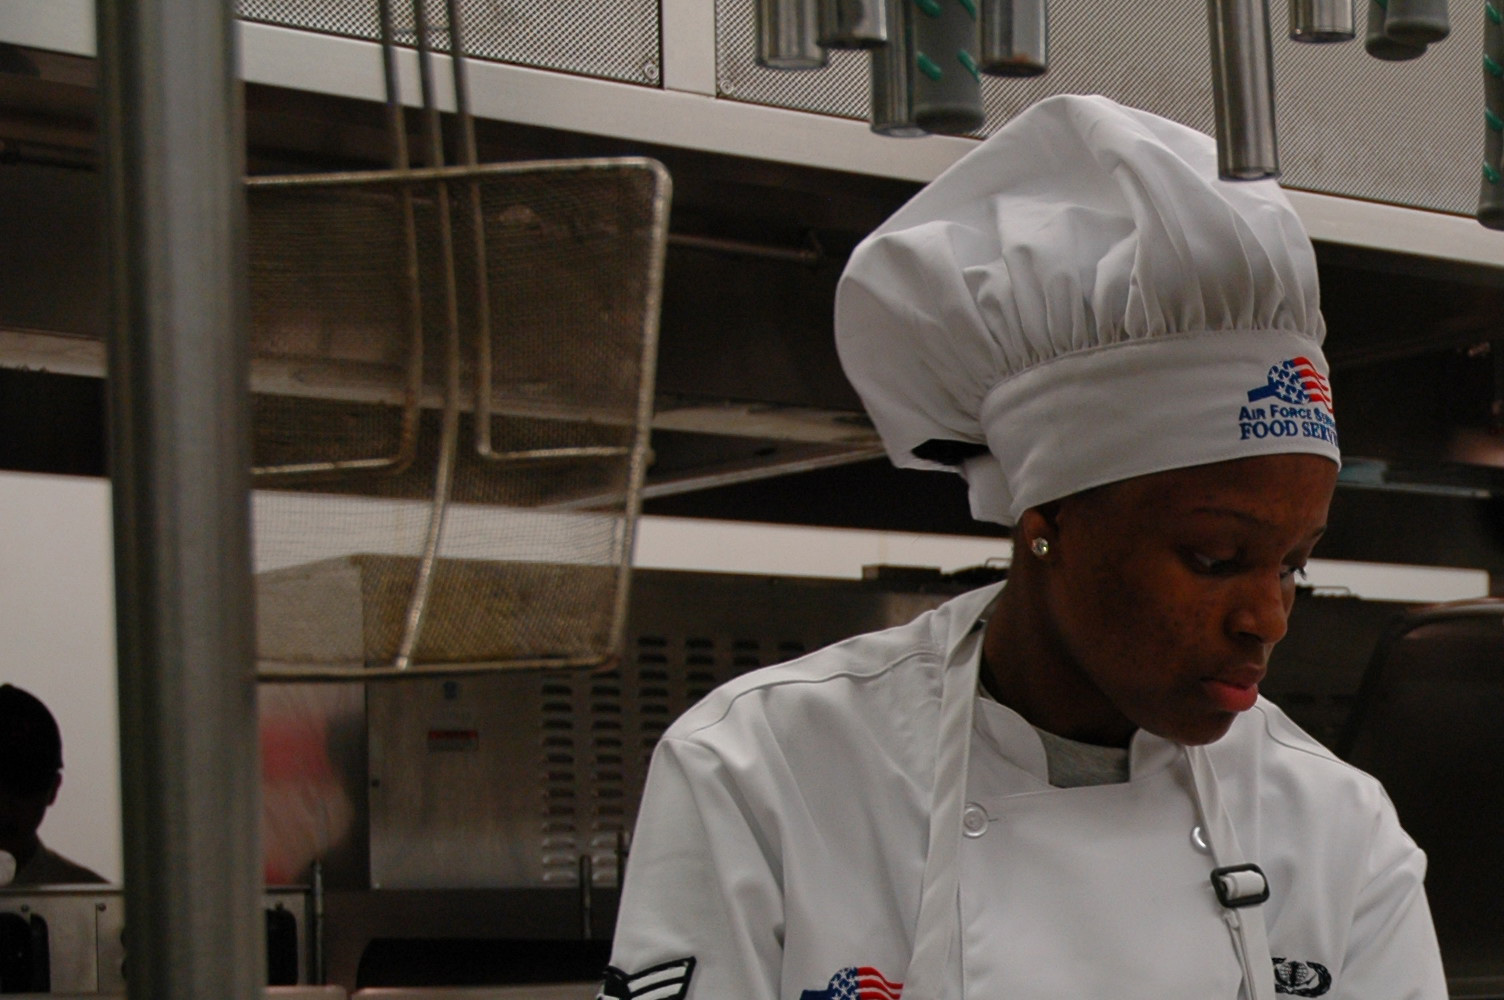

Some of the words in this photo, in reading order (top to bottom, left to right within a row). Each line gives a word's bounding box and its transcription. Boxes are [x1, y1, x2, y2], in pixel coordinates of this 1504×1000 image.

[1239, 406, 1266, 420] AIR
[1270, 404, 1312, 419] FORCE
[1239, 420, 1298, 440] FOOD
